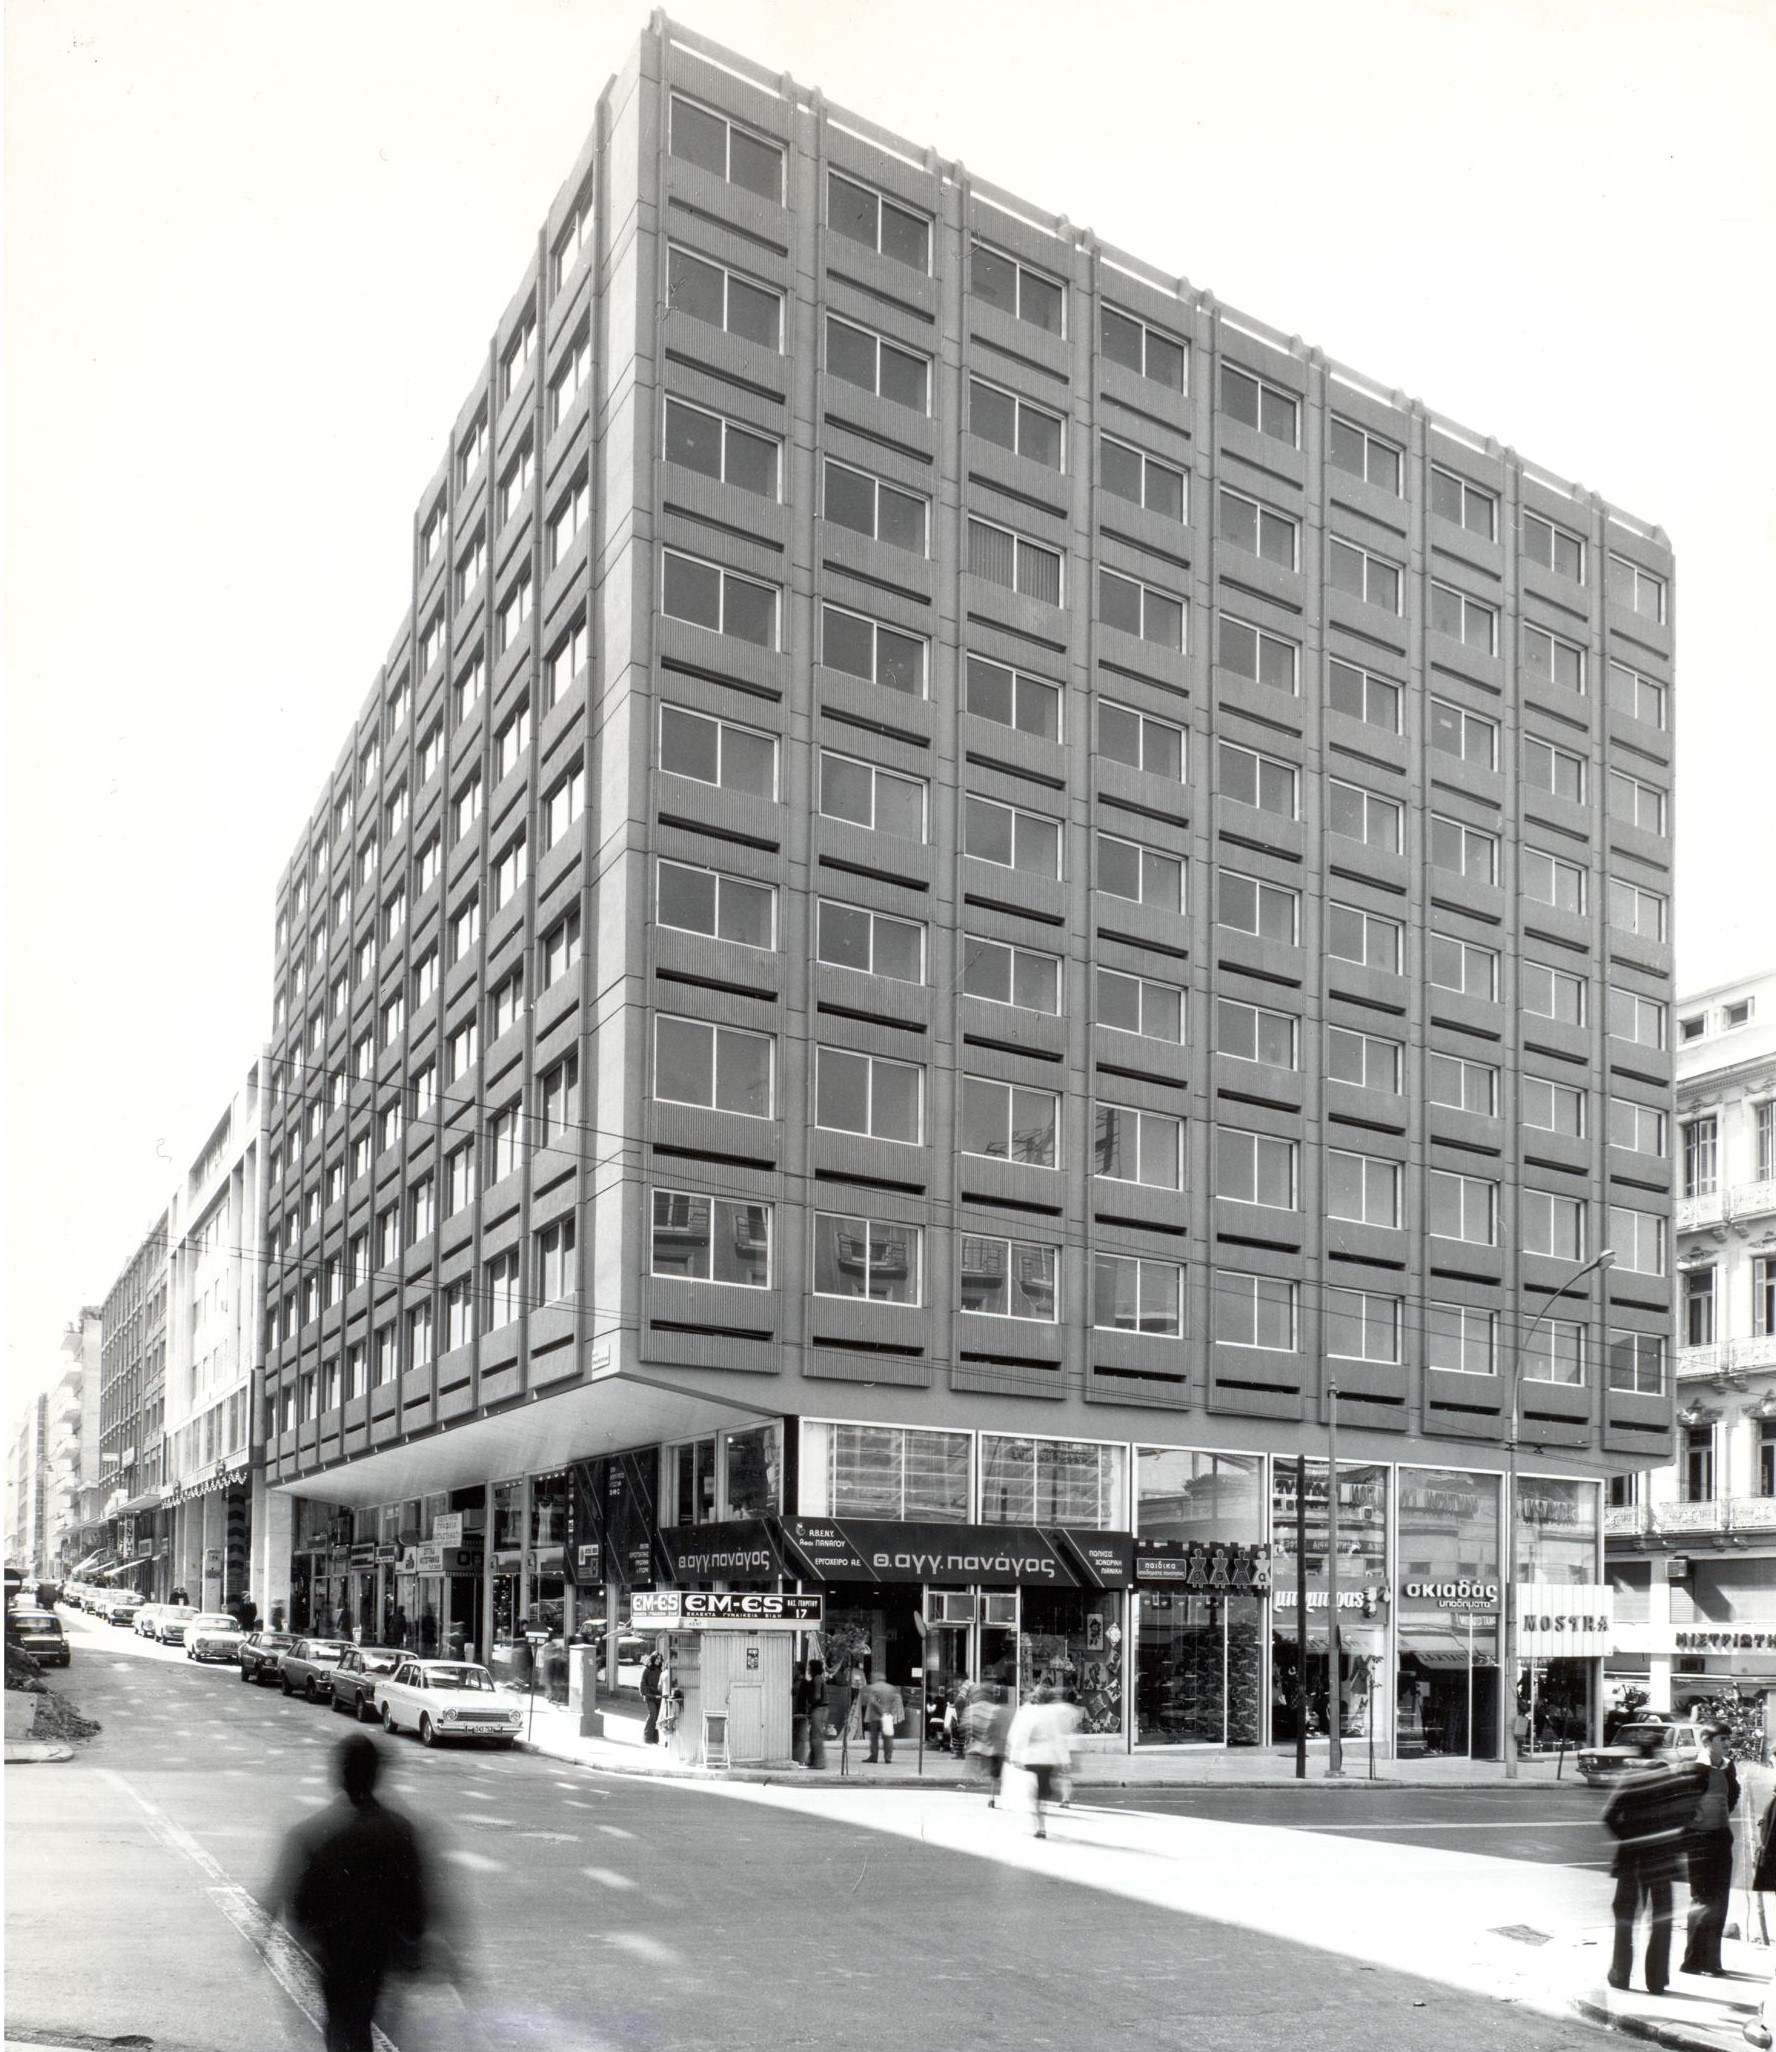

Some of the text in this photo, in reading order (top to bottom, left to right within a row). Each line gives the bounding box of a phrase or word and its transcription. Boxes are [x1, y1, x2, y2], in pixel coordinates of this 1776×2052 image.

[815, 1539, 846, 1548] ΠΑΝΑΓΟΥ
[814, 1557, 849, 1566] ΕΡΓΟΧΕΙΡΟ
[1406, 1579, 1498, 1602] σκιαδάς
[685, 1594, 783, 1613] EM-ES
[795, 1608, 807, 1619] 17
